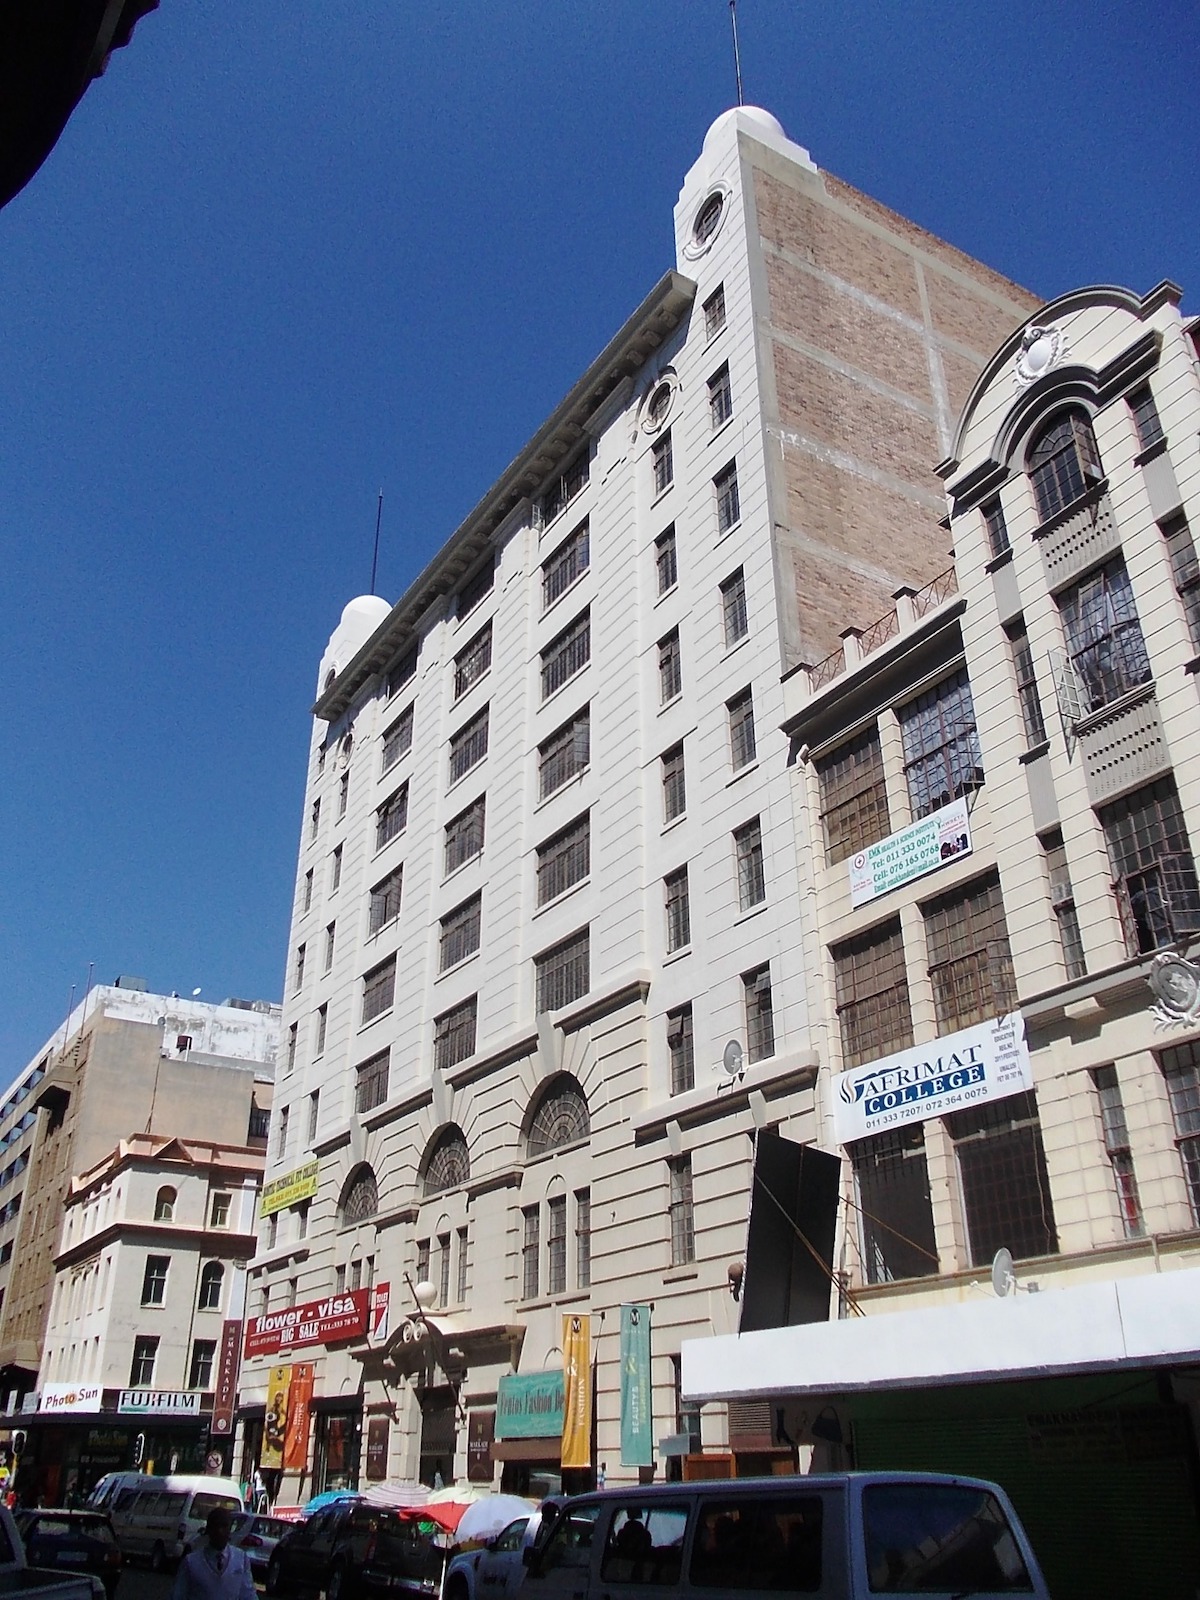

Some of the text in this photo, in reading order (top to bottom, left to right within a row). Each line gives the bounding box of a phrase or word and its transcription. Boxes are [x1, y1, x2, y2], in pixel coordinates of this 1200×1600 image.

[872, 832, 937, 871] Tel: 011 333 0074
[873, 843, 940, 882] Cell: 076 165 0768
[865, 1043, 982, 1098] AFRIMAT
[868, 1066, 982, 1113] COLLEGE
[865, 1118, 881, 1129] 011
[883, 1113, 898, 1124] 333
[925, 1100, 943, 1111] 072
[945, 1094, 963, 1106] 364
[964, 1086, 988, 1101] 0075
[255, 1308, 304, 1333] flower
[318, 1297, 356, 1318] visa
[280, 1326, 295, 1344] BIG
[299, 1321, 320, 1339] SALE
[45, 1394, 75, 1409] Photo
[78, 1388, 99, 1402] Sun
[121, 1392, 195, 1407] FUJIFILM
[525, 1387, 553, 1415] Fashion
[578, 1378, 586, 1426] FASHION
